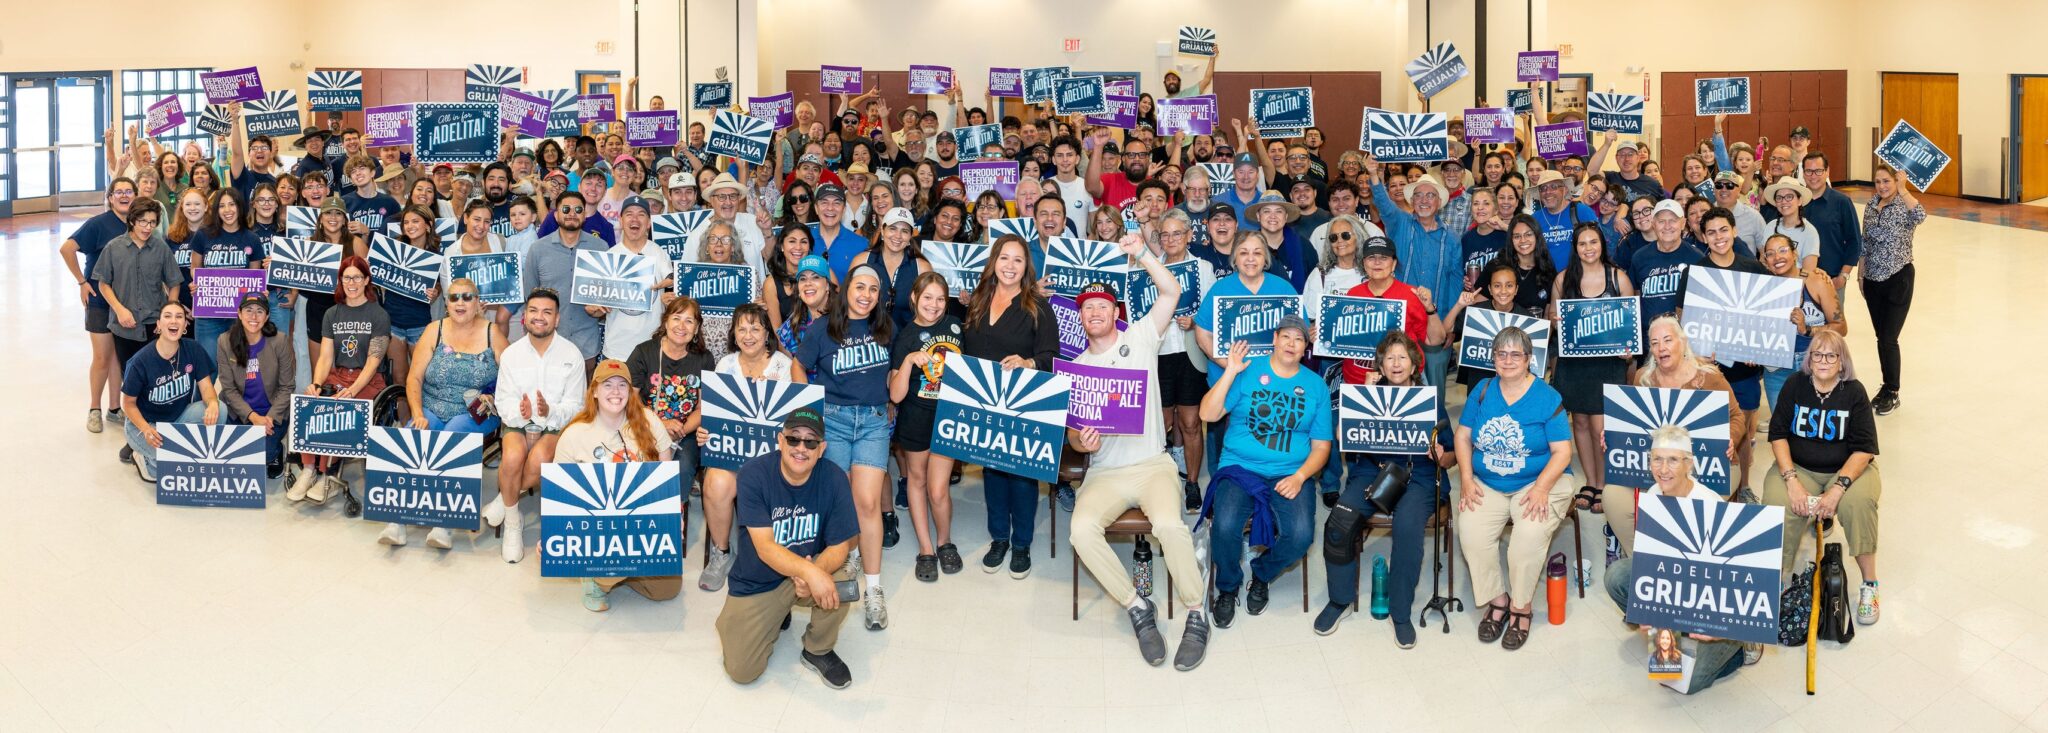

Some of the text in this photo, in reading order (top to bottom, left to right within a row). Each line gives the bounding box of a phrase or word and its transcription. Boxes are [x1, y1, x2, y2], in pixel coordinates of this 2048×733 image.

[1065, 39, 1080, 51] EXIT
[1181, 43, 1213, 52] GRIJALVA
[1560, 44, 1572, 56] EXIT
[203, 72, 258, 85] REPRODUCTIVE
[1419, 62, 1466, 94] GRIJALVA
[206, 79, 259, 92] FREEDOM ALL
[209, 89, 239, 99] ARIZONA
[310, 96, 360, 105] GRIJALVA
[1062, 86, 1094, 107] ¡ADELITA!
[1705, 84, 1739, 106] ¡ADELITA!
[1123, 108, 1135, 116] ALL
[1160, 105, 1209, 113] REPRODUCTIVE
[1262, 96, 1301, 120] ¡ADELITA!
[628, 116, 676, 125] REPRODUCTIVE
[1160, 112, 1209, 120] FREEDOM ALL
[248, 119, 298, 132] GRIJALVA
[367, 121, 401, 130] FREEDOM
[628, 124, 658, 132] FREEDOM
[1160, 119, 1190, 128] ARIZONA
[1466, 121, 1495, 129] FREEDOM
[1591, 117, 1639, 129] GRIJALVA
[429, 117, 485, 150] ¡ADELITA!
[629, 131, 657, 140] ARIZONA
[1467, 128, 1492, 136] ARIZONA
[1537, 127, 1583, 140] REPRODUCTIVE
[712, 137, 761, 157] GRIJALVA
[1538, 134, 1584, 147] FREEDOM ALL
[1375, 145, 1443, 156] GRIJALVA
[1540, 144, 1566, 154] ARIZONA
[1894, 139, 1937, 168] ¡ADELITA!
[962, 168, 1016, 177] REPRODUCTIVE
[963, 176, 1016, 185] FREEDOM ALL
[283, 263, 326, 274] ADELITA
[380, 263, 422, 281] ADELITA
[1060, 268, 1110, 278] ADELITA
[197, 276, 263, 288] REPRODUCTIVE
[272, 268, 333, 285] GRIJALVA
[370, 265, 428, 293] GRIJALVA
[197, 286, 239, 298] FREEDOM
[578, 284, 647, 302] GRIJALVA
[689, 275, 739, 299] ¡ADELITA!
[197, 296, 235, 308] ARIZONA
[1240, 303, 1252, 315] All
[1261, 300, 1272, 312] for
[332, 321, 372, 331] science
[1573, 308, 1624, 344] ¡ADELITA!
[1702, 311, 1777, 329] ADELITA
[1332, 311, 1387, 343] ¡ADELITA!
[1683, 321, 1790, 352] GRIJALVA
[832, 341, 889, 376] ¡ADELITA!
[149, 373, 191, 402] ¡ADELITA!
[1069, 388, 1108, 407] EEDOM
[1119, 394, 1142, 408] ALL
[314, 404, 326, 414] All
[334, 402, 345, 414] for
[305, 410, 356, 440] ¡ADELITA!
[958, 409, 1040, 435] ADELITA
[1359, 421, 1417, 429] ADELITA
[722, 423, 776, 438] ADELI
[1346, 427, 1429, 444] GRIJALVA
[938, 418, 1055, 464] GRIJALVA
[705, 452, 745, 462] DEMOCRAT
[935, 439, 978, 453] DEMOCRAT
[1011, 458, 1054, 471] CONGRESS
[1609, 448, 1726, 477] GRIVA
[176, 465, 247, 475] ADELITA
[160, 475, 262, 494] GRIJALVA
[385, 475, 462, 489] ADELITA
[368, 486, 478, 514] GRIJALVA
[368, 506, 407, 514] DEMOCRAT
[771, 507, 785, 520] All
[793, 504, 806, 518] for
[565, 519, 657, 530] ADELITA
[545, 533, 677, 557] GRIJALVA
[1657, 561, 1753, 584] ADELITA
[1635, 576, 1773, 619] GRIJALVA
[1633, 603, 1682, 616] DEMOCRAT
[1722, 617, 1773, 629] CONGRESS
